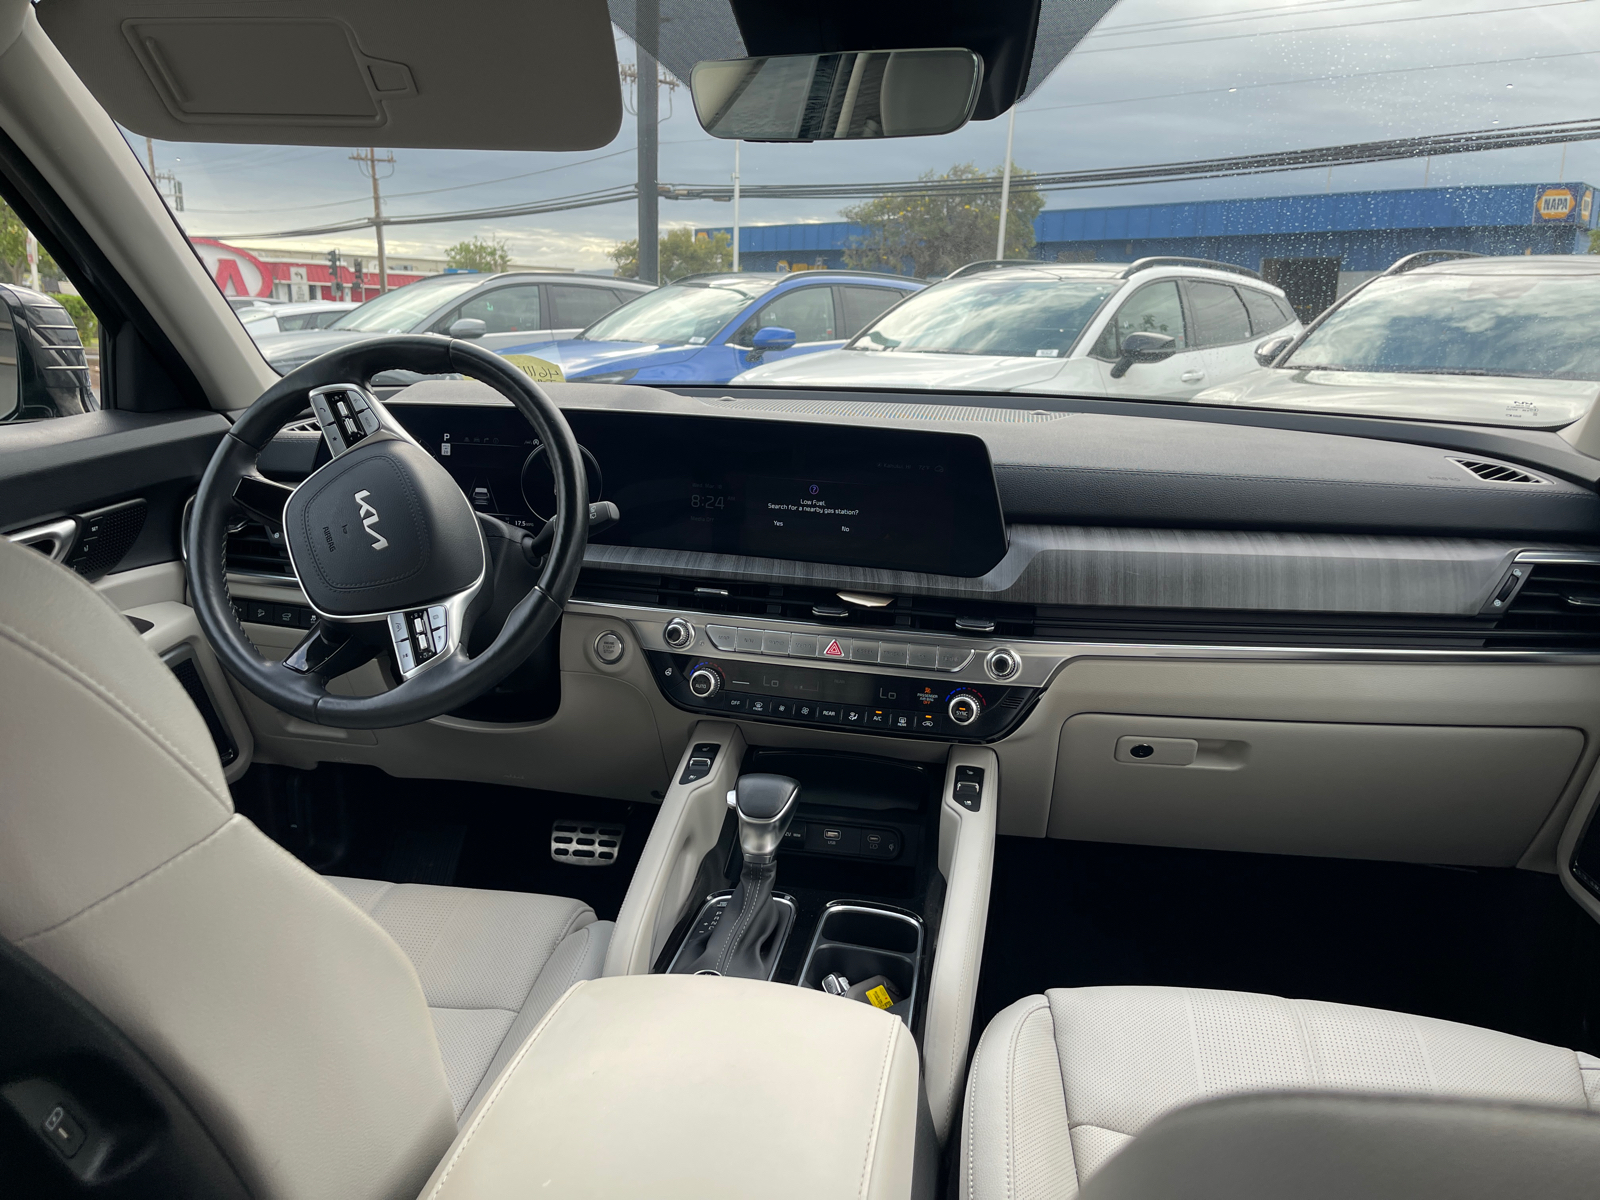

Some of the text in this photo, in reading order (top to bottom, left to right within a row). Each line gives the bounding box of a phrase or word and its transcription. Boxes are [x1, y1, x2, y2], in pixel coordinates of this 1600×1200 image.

[1542, 197, 1569, 212] NAPA
[443, 433, 450, 442] P
[690, 494, 725, 510] 8:24
[322, 526, 336, 553] AIRBAG
[763, 676, 779, 687] Lo
[880, 687, 896, 699] Lo
